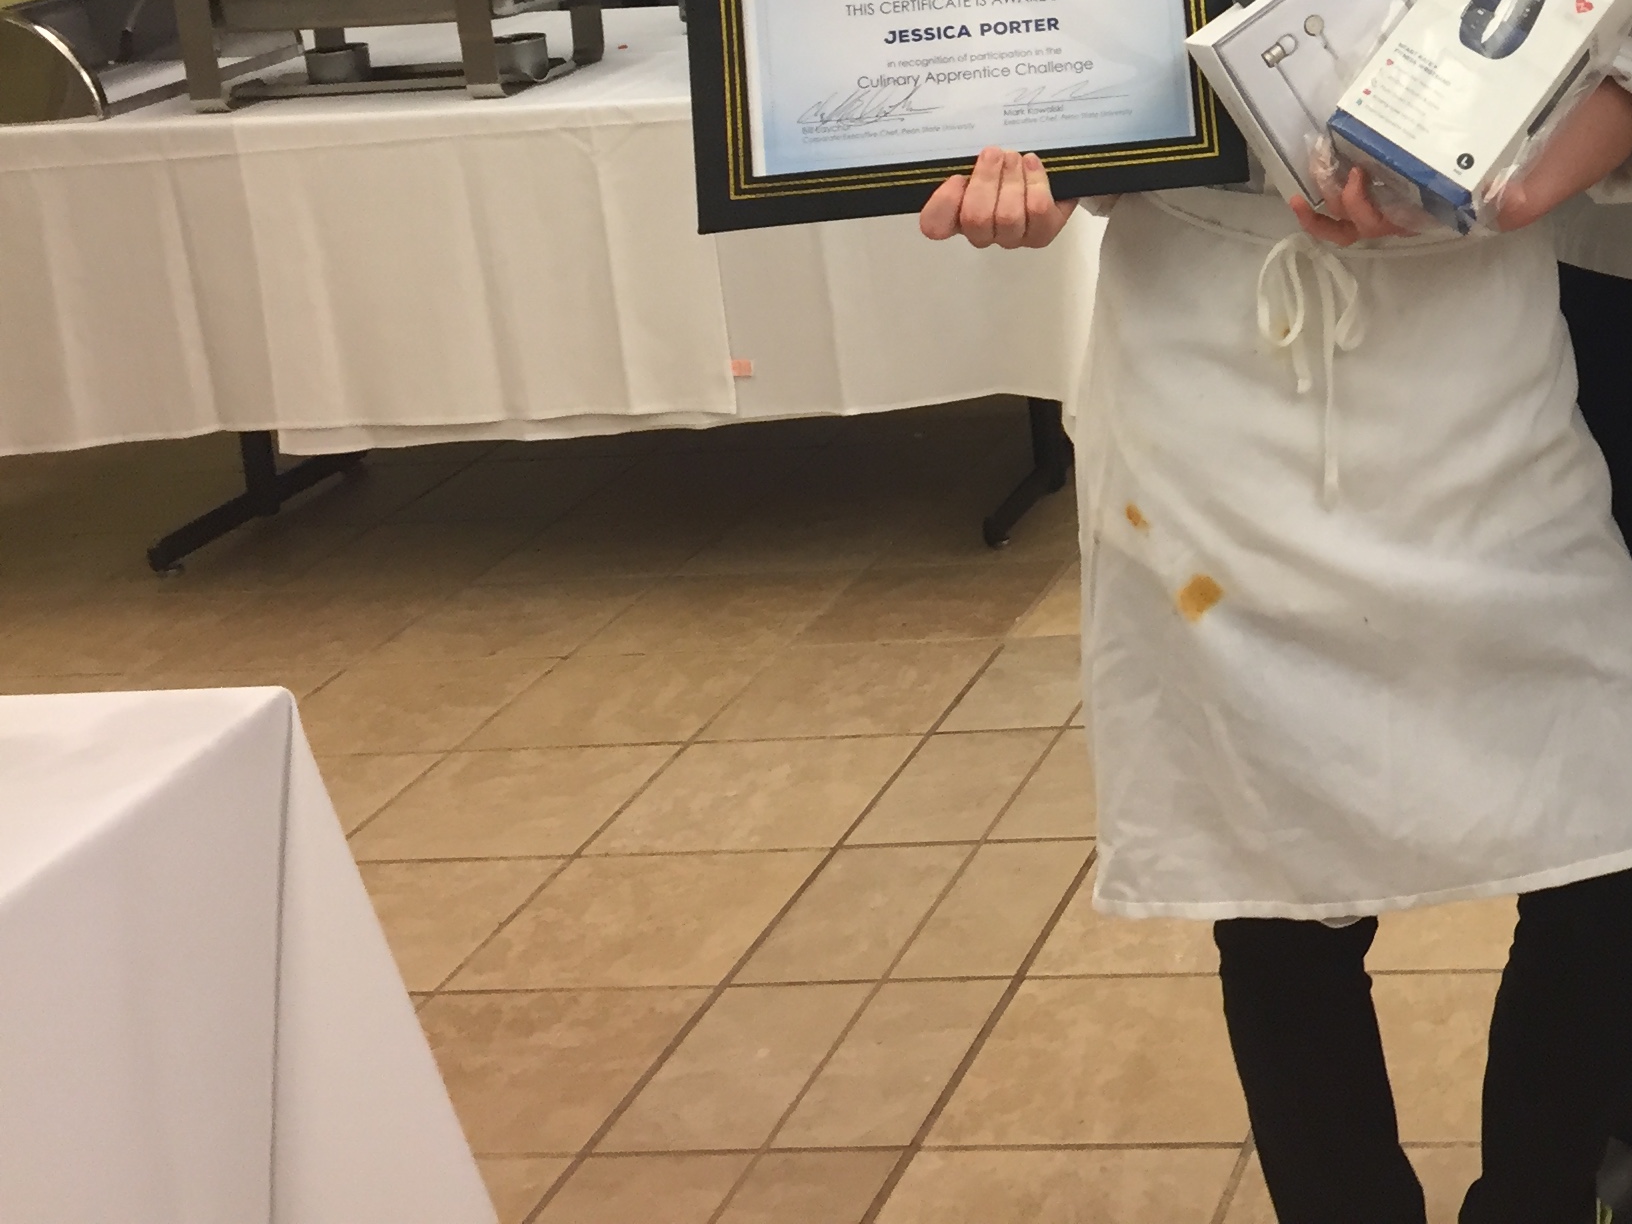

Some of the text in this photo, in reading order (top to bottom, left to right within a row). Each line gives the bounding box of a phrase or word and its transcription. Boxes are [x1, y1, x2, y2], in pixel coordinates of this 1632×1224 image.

[845, 3, 875, 17] THIS
[883, 17, 1060, 45] JESSICA PORTER
[897, 54, 956, 69] recognition
[957, 53, 968, 63] of
[970, 48, 1033, 63] participation
[1045, 46, 1062, 55] the
[857, 57, 1095, 90] Culinary Apprentice Challenge
